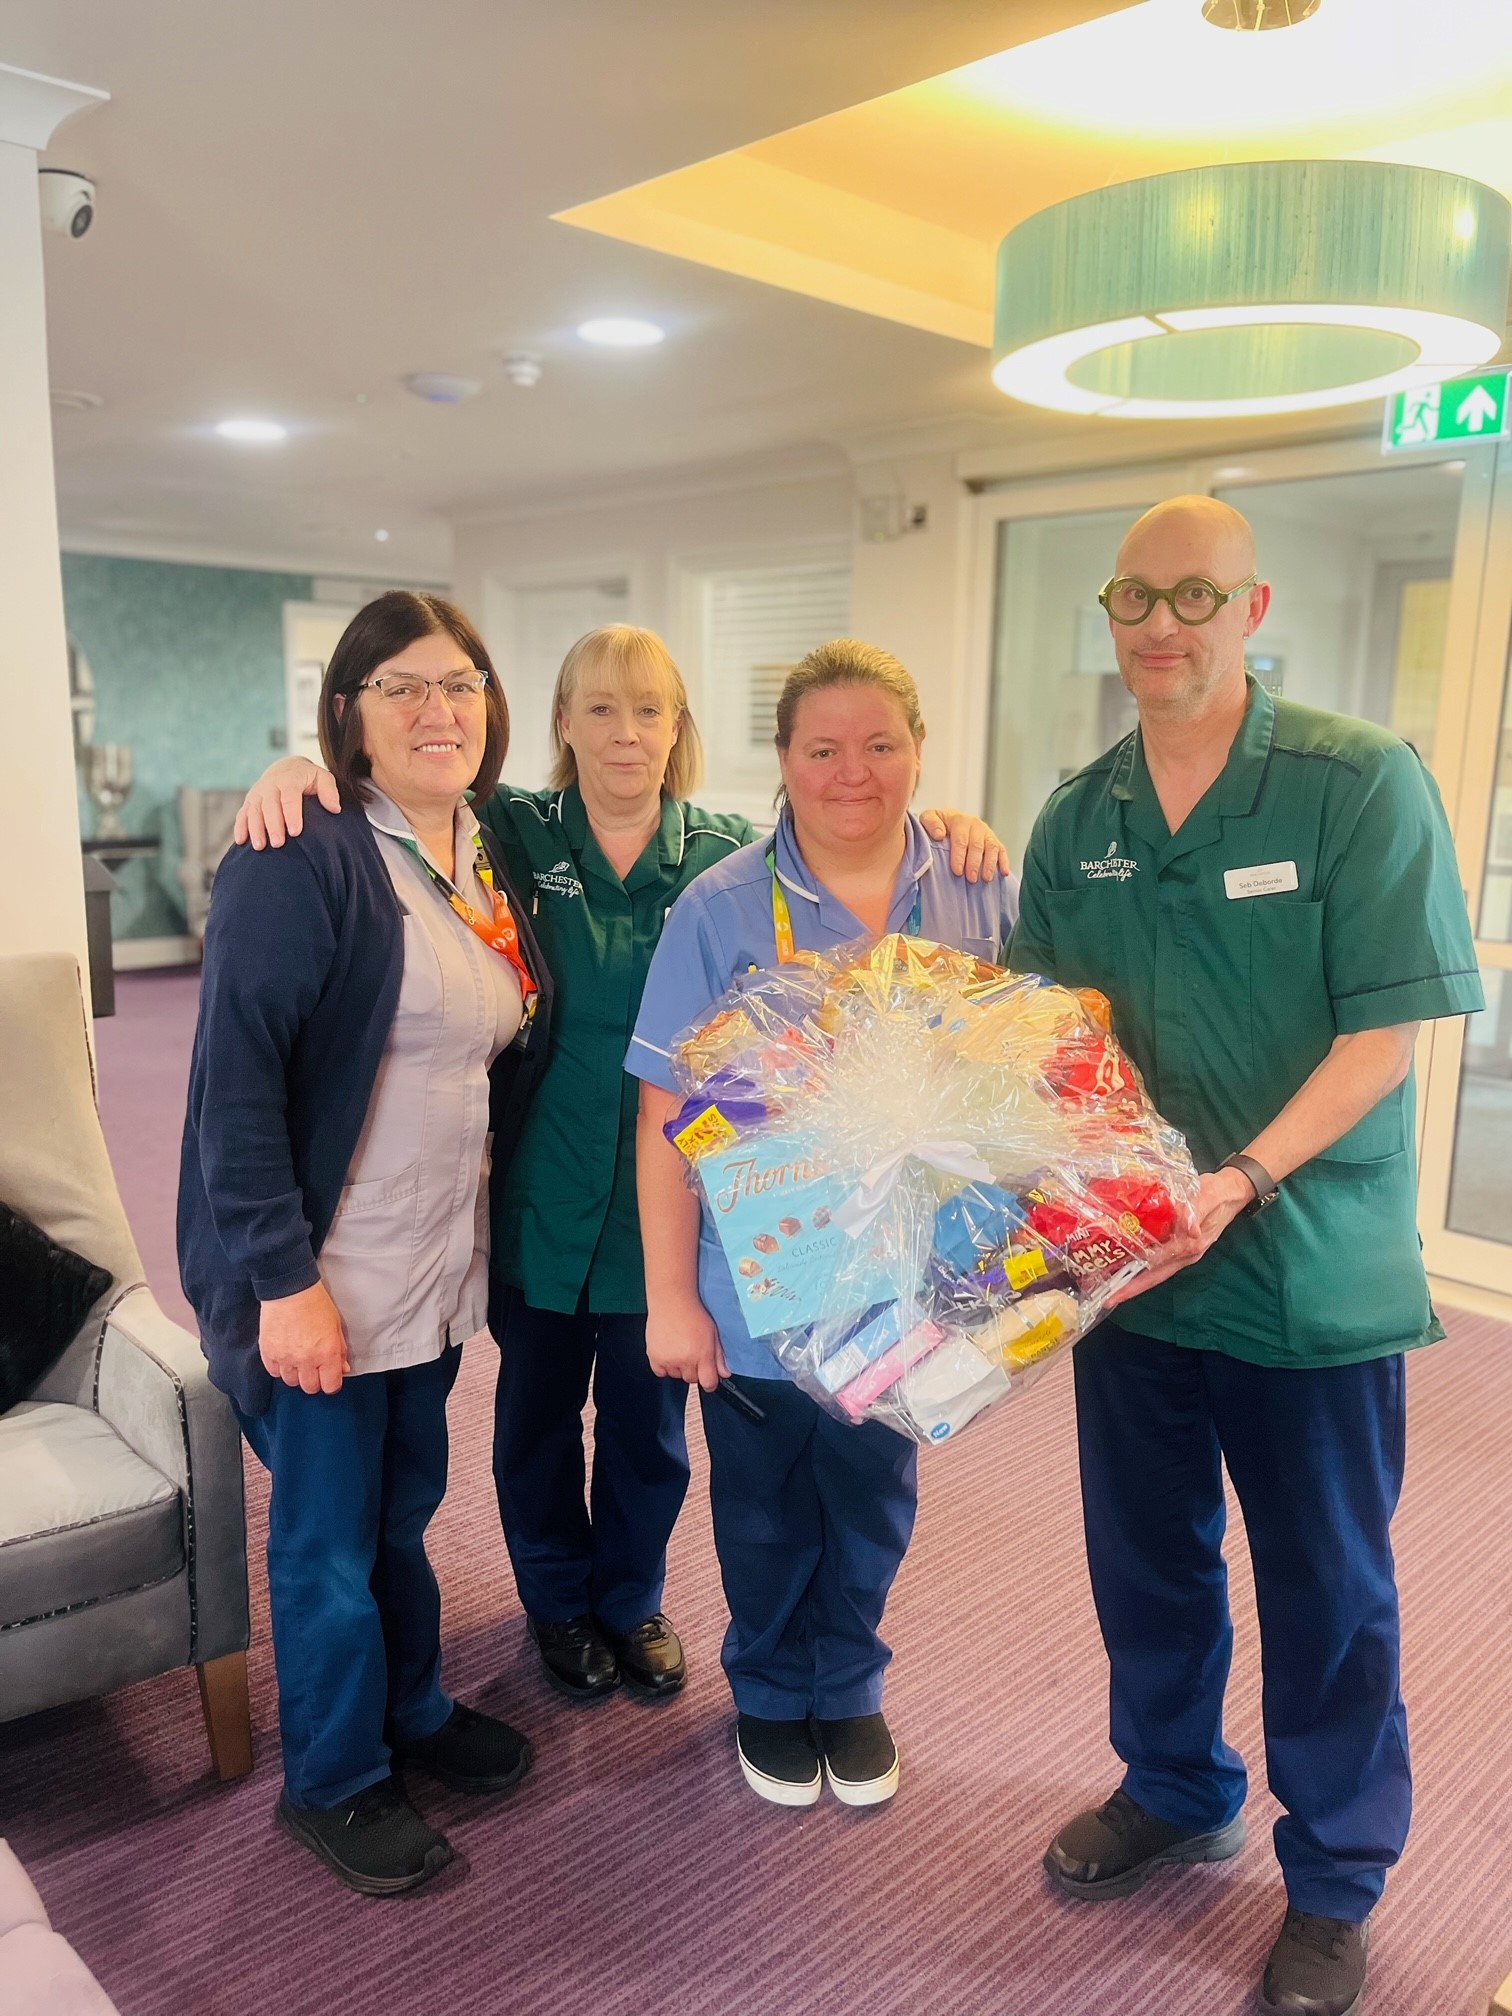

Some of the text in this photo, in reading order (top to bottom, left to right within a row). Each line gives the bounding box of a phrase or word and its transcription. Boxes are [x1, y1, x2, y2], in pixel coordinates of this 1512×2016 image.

[1080, 859, 1140, 871] BARCHTER
[791, 1236, 838, 1258] CLASSIC
[932, 1423, 948, 1438] New
